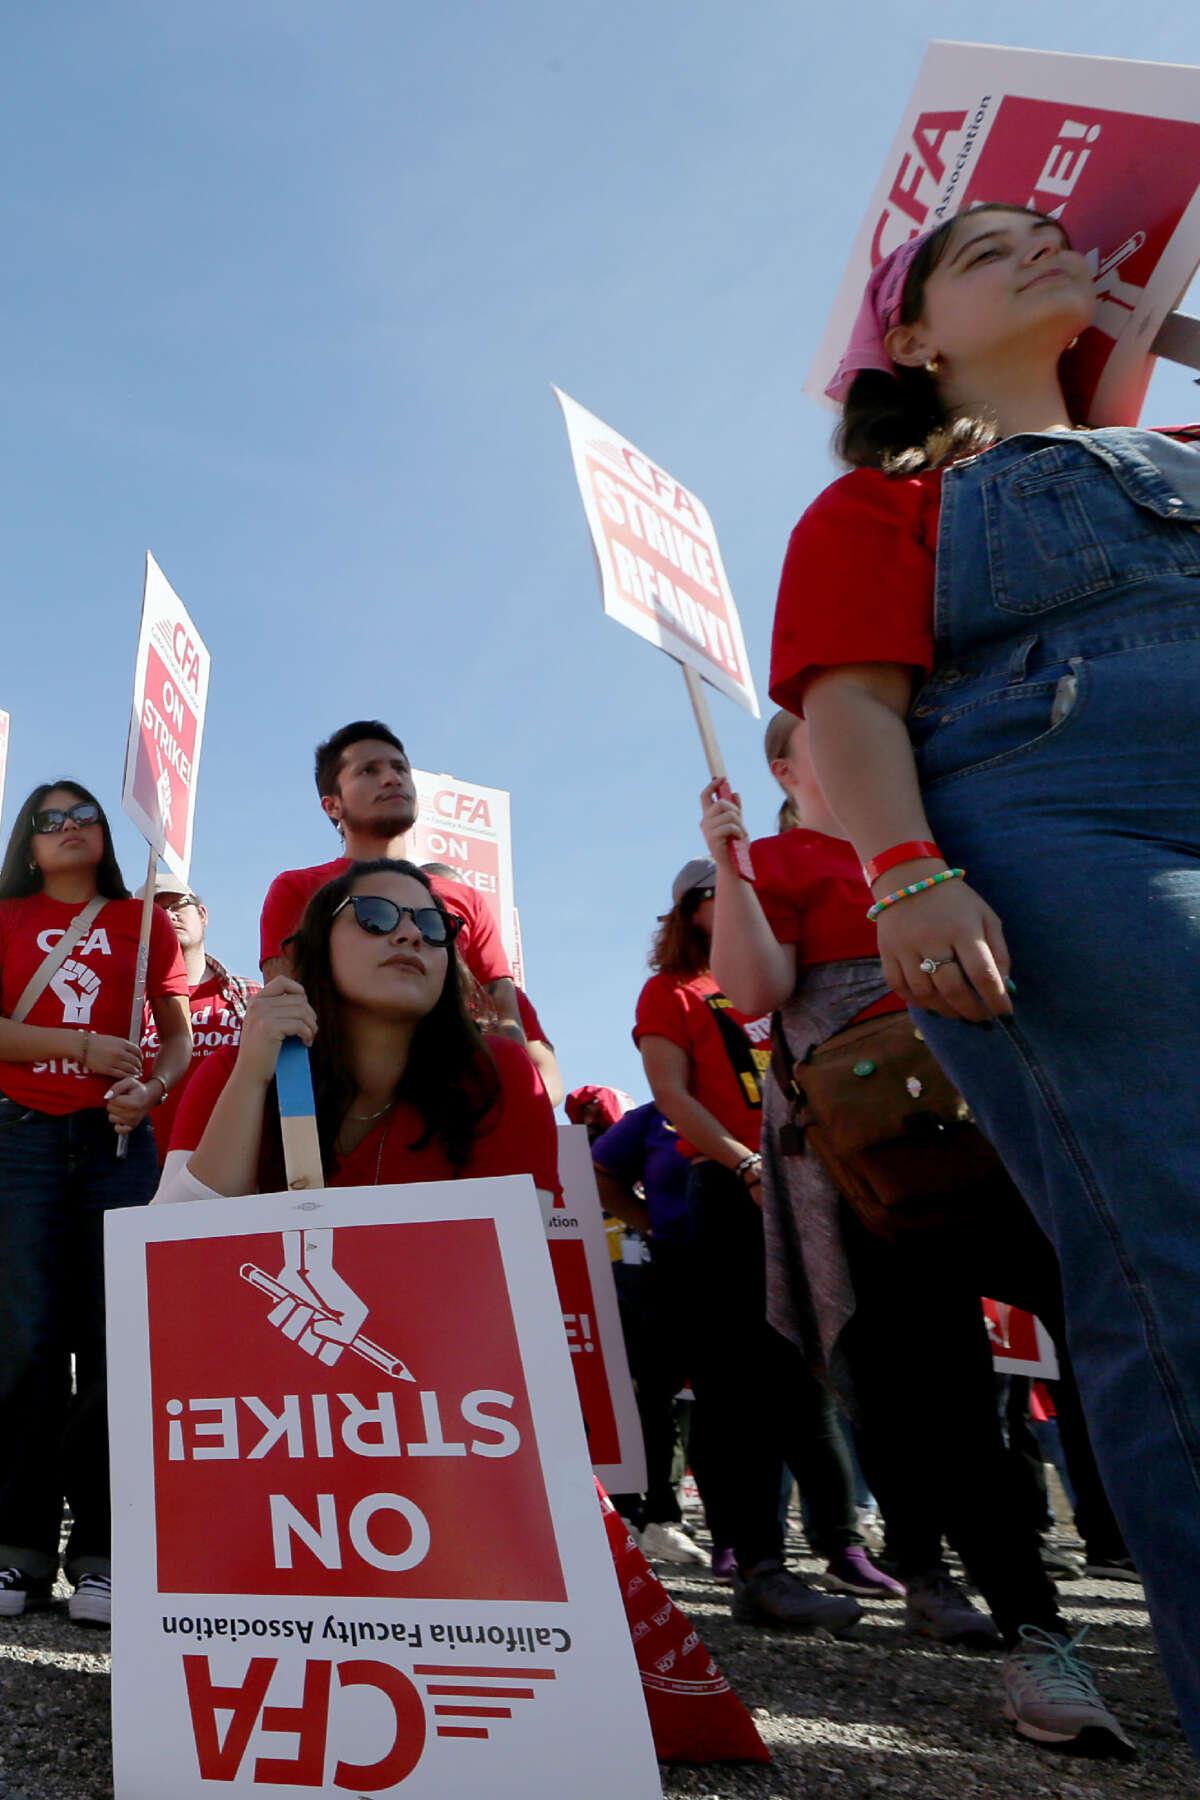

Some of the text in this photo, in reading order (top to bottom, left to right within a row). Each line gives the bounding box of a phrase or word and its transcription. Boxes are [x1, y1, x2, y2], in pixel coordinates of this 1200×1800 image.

[870, 109, 969, 269] CFA
[934, 94, 992, 219] Association
[622, 448, 702, 528] CFA
[593, 469, 721, 598] STRIKE
[172, 621, 200, 695] CFA
[142, 697, 192, 788] STRIKE!
[162, 680, 185, 734] ON
[427, 833, 469, 861] ON
[433, 790, 492, 827] CFA
[165, 1389, 521, 1461] STRIKE!
[269, 1492, 431, 1572] ON
[161, 1615, 572, 1652] California Faculty Association
[182, 1654, 426, 1792] CFA
